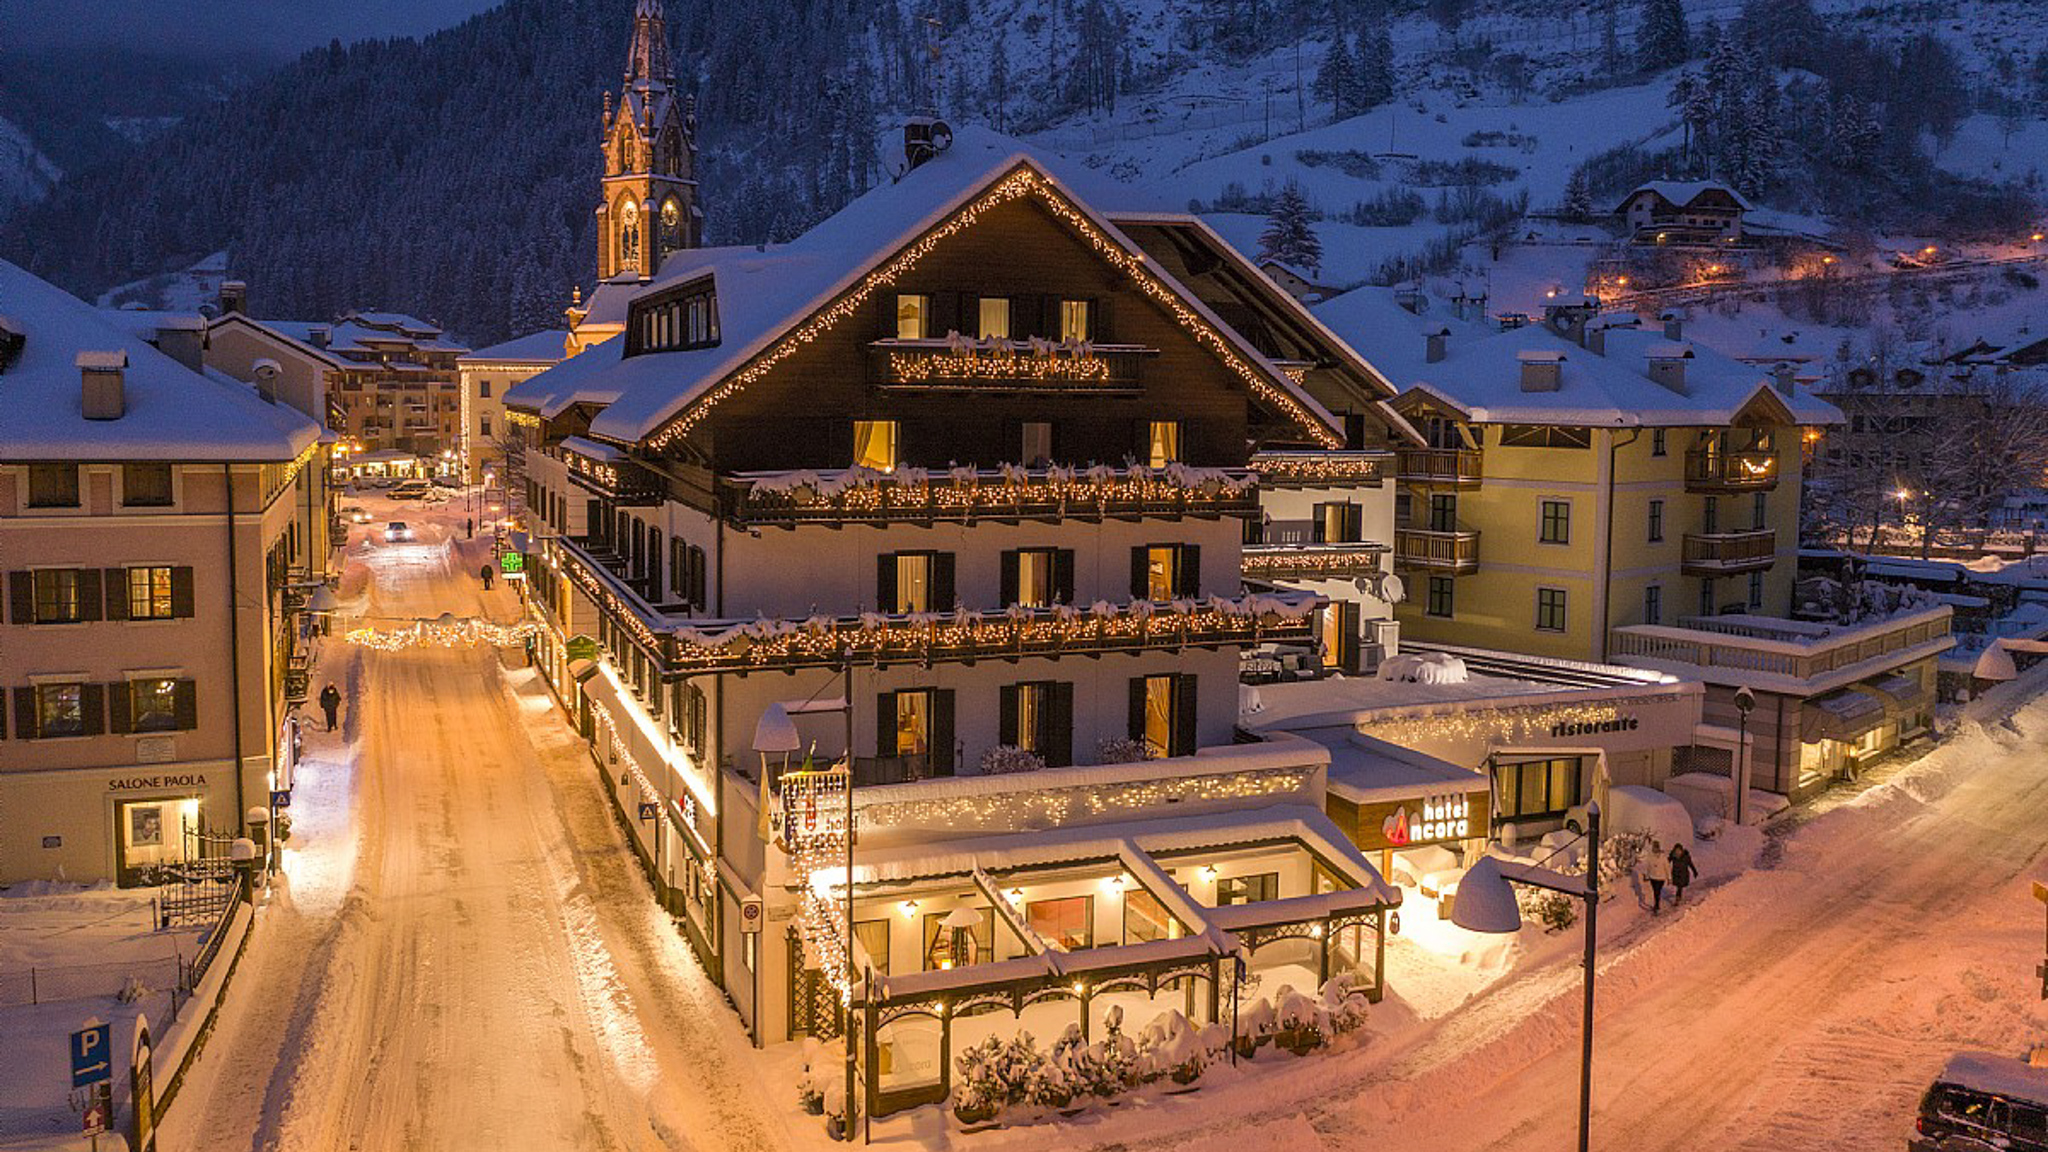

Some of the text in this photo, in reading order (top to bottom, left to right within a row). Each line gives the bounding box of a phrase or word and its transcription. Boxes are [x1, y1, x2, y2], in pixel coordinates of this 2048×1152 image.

[1551, 716, 1639, 738] ristorante
[108, 774, 206, 791] SALONE PAOLA
[1423, 801, 1468, 821] hotel
[81, 1030, 100, 1057] P
